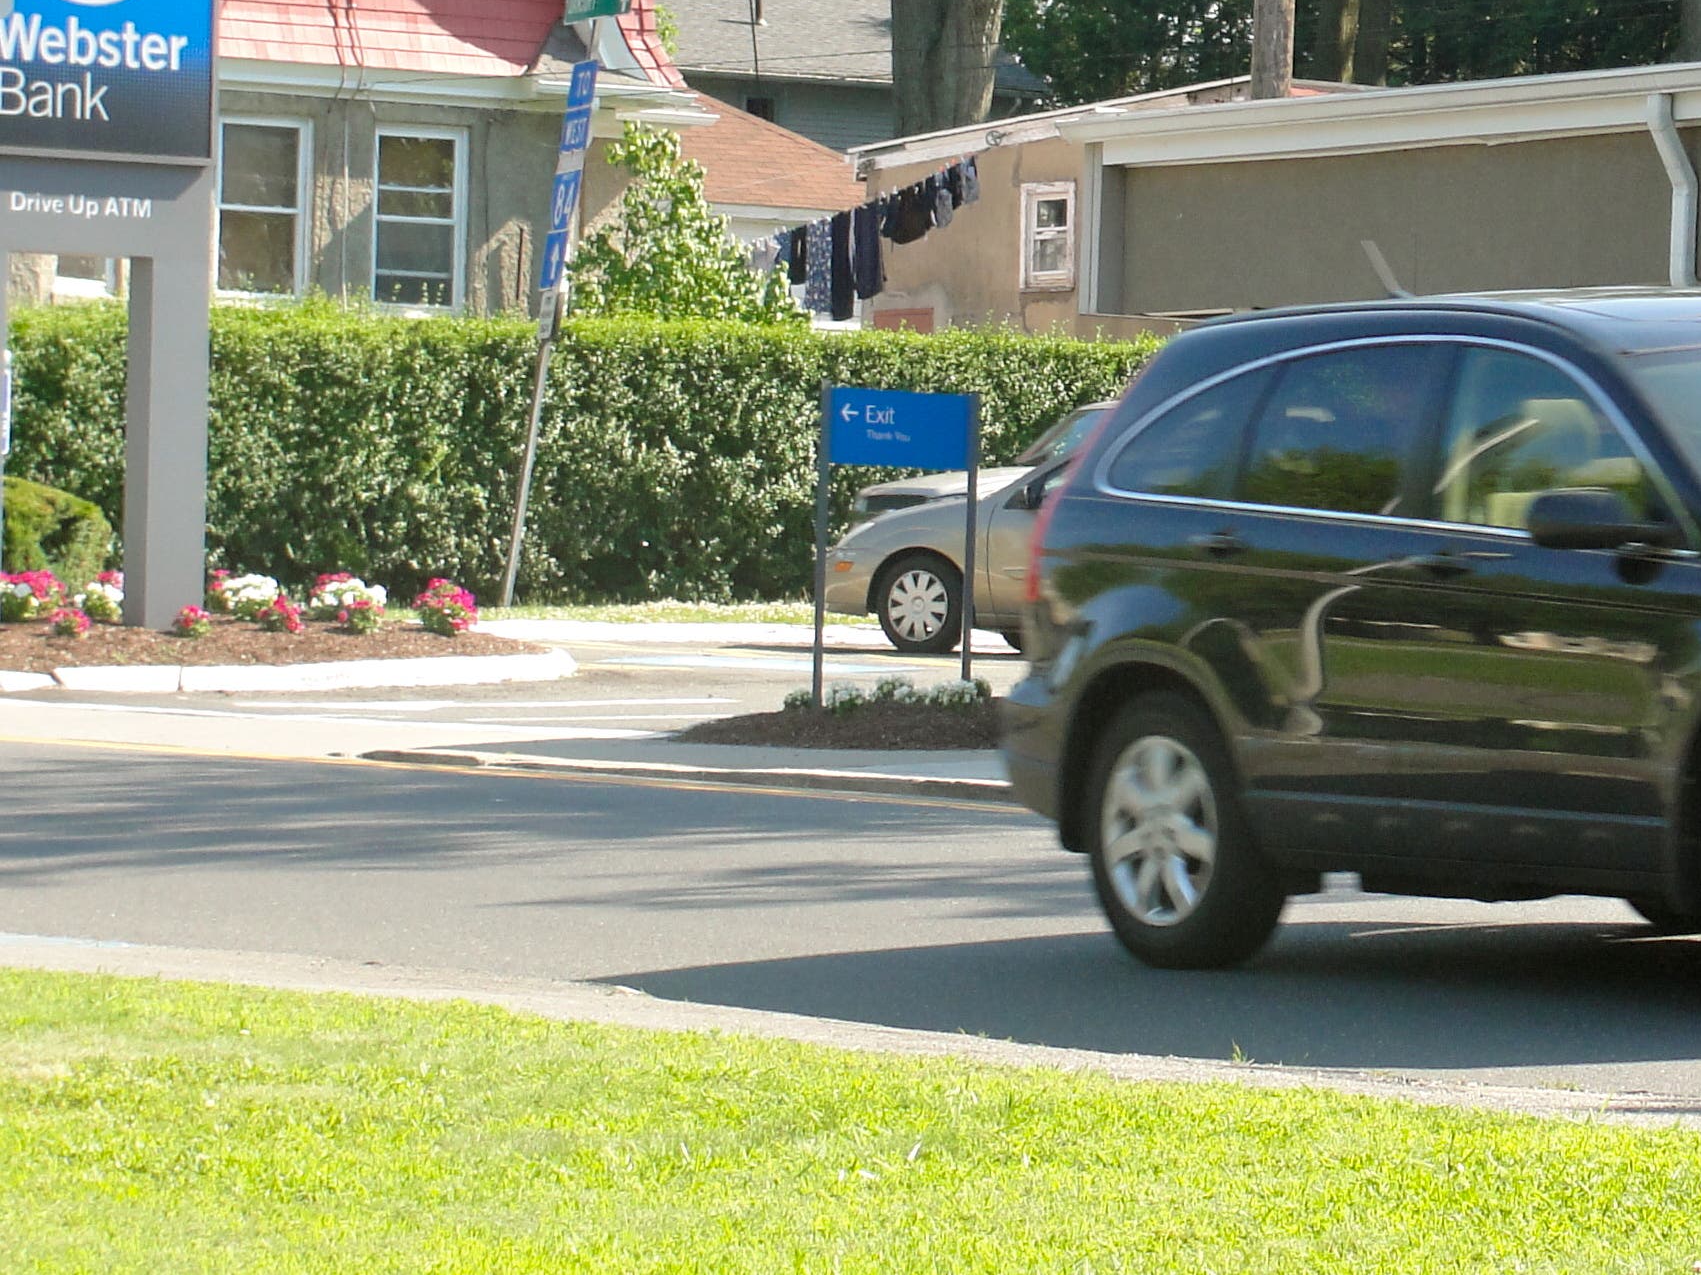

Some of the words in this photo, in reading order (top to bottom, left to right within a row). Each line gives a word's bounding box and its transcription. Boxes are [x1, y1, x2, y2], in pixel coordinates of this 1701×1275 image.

[0, 12, 188, 71] Webster
[0, 66, 110, 121] Bank
[577, 70, 592, 98] TO
[564, 117, 589, 146] WEST
[10, 191, 64, 214] Drive
[69, 194, 99, 219] Up
[104, 197, 151, 218] ATM
[554, 182, 575, 226] 84
[865, 404, 896, 425] Exit
[866, 429, 893, 441] Thank
[895, 431, 911, 442] You
